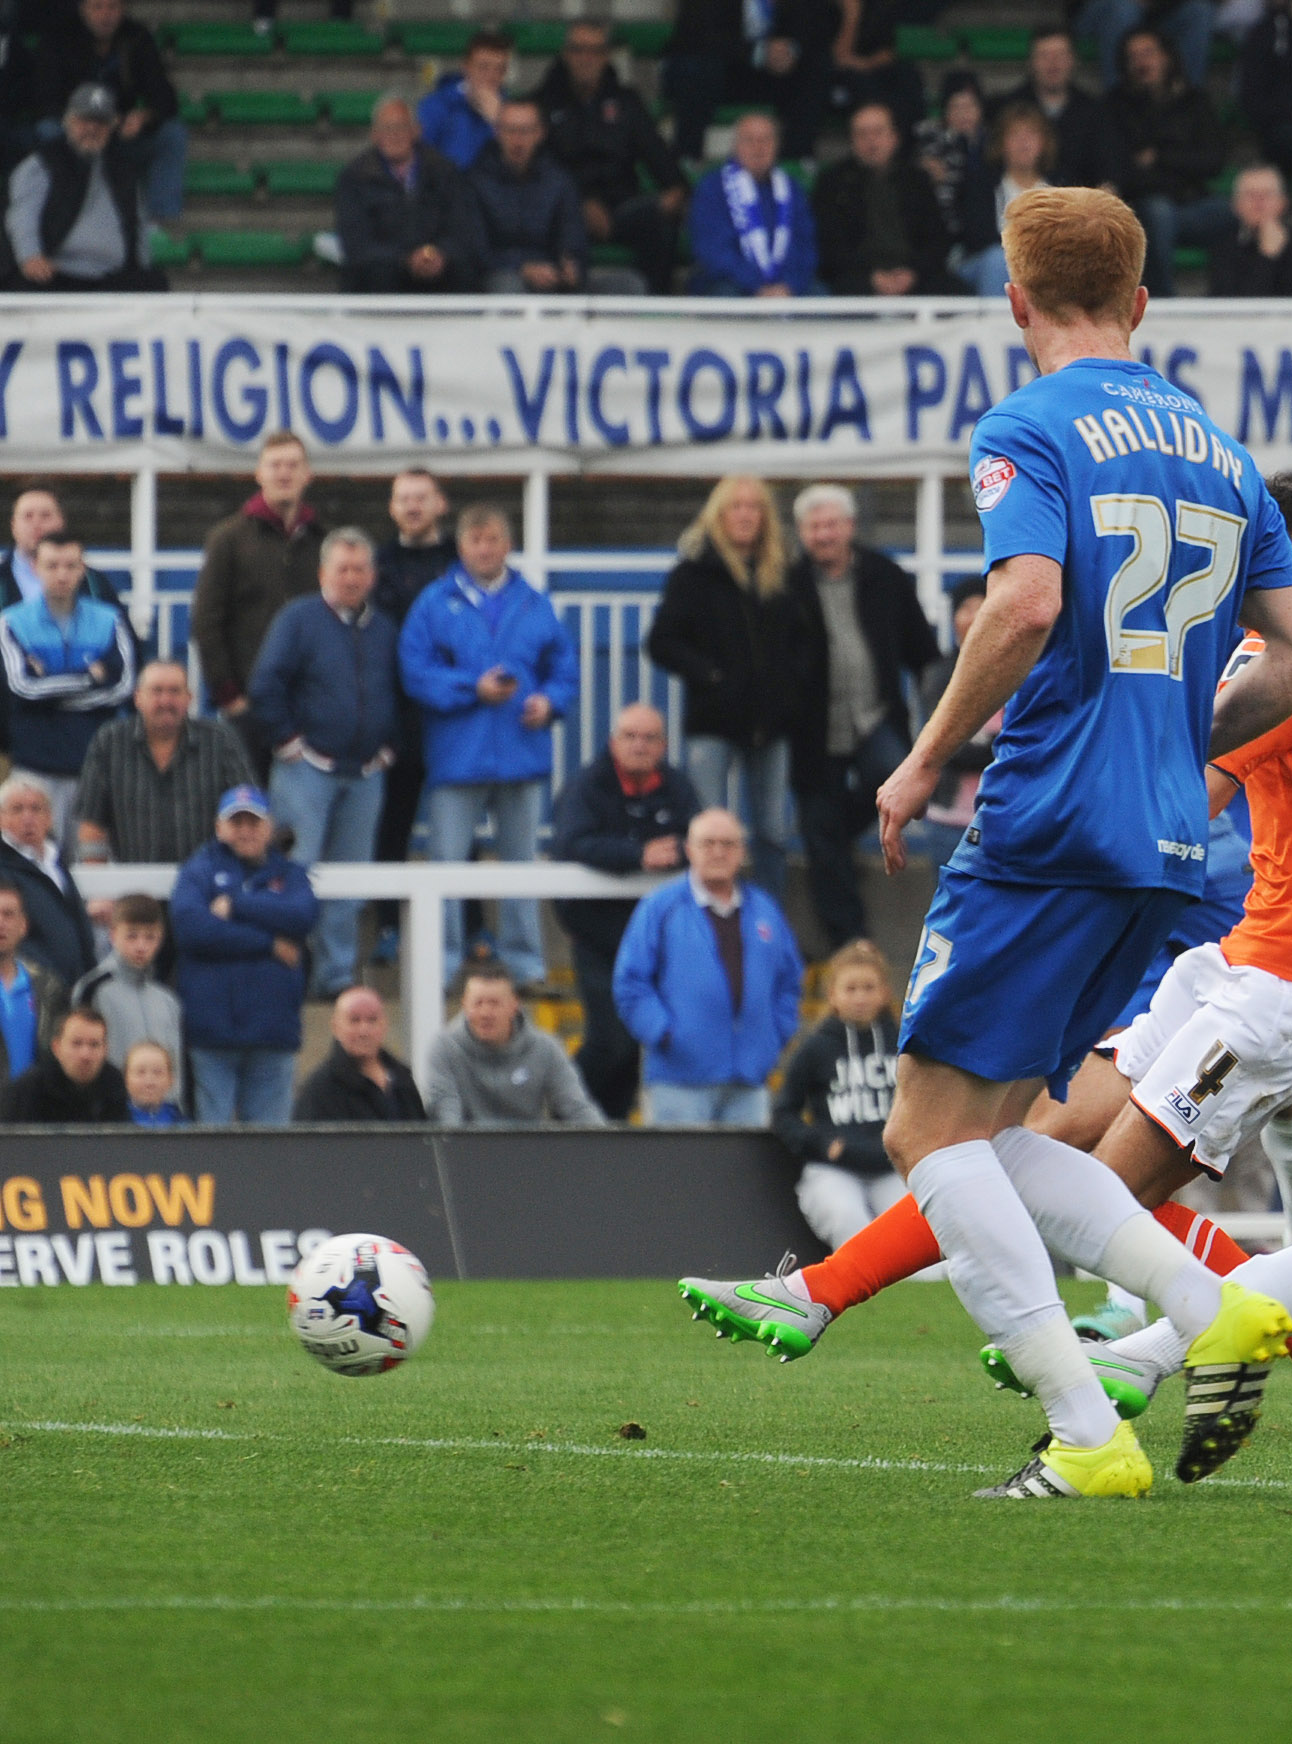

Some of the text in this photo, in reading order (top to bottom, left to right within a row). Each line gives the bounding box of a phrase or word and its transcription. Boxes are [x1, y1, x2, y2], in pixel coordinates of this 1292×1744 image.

[1073, 404, 1243, 491] HALLIDAY
[1089, 493, 1248, 682] 27
[1186, 1038, 1239, 1106] 4
[59, 1172, 216, 1230] NOW
